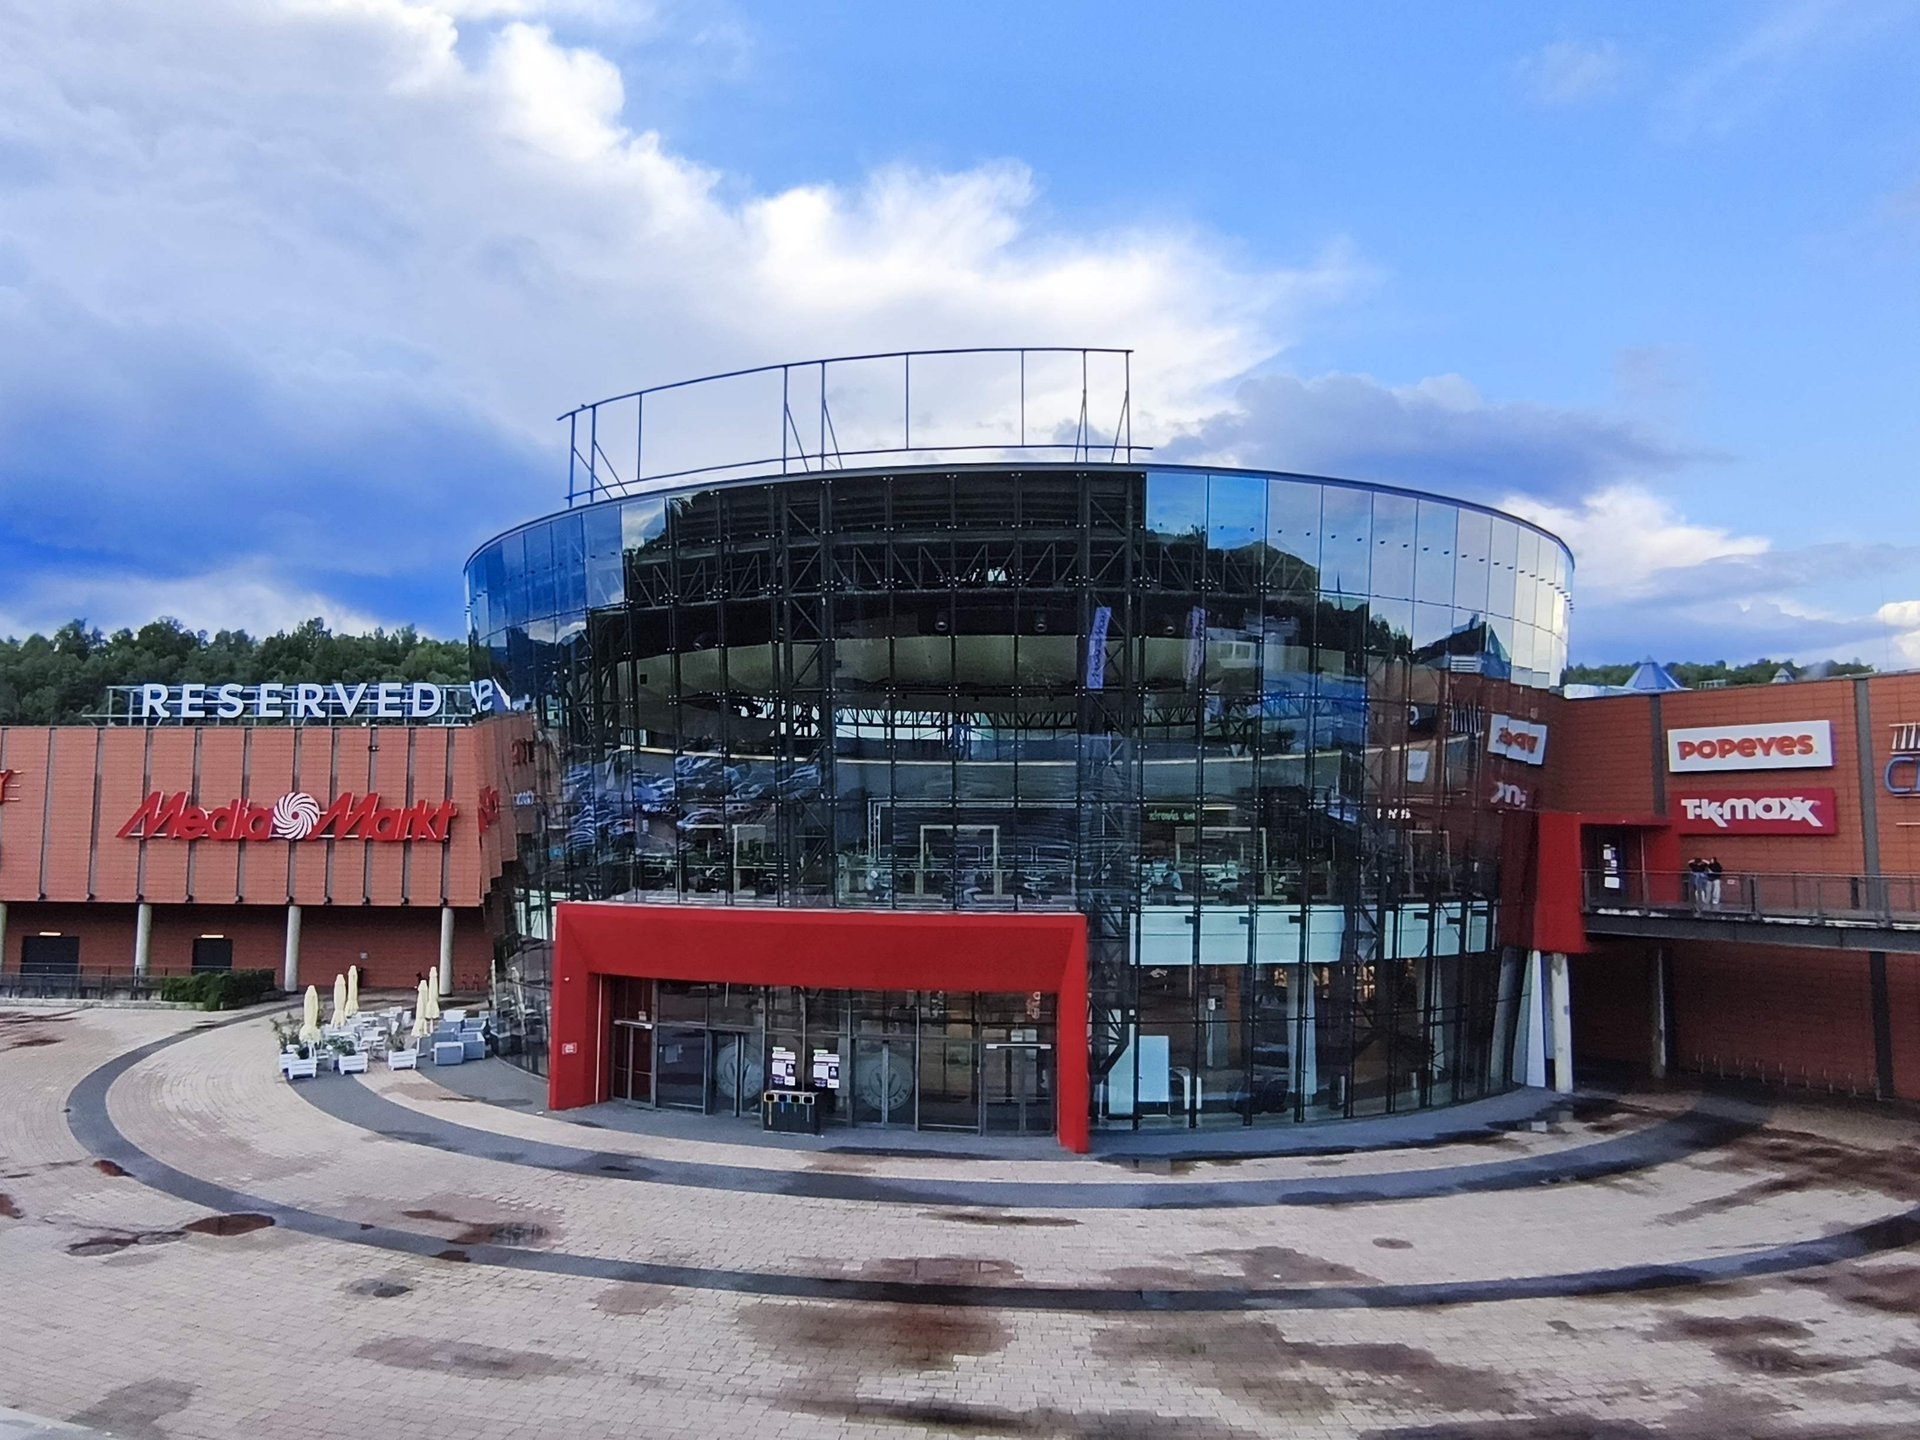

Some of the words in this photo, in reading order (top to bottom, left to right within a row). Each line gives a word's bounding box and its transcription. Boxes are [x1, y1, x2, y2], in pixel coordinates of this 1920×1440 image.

[142, 682, 442, 718] RESERVED
[116, 791, 274, 841] Media
[307, 791, 458, 842] Markt
